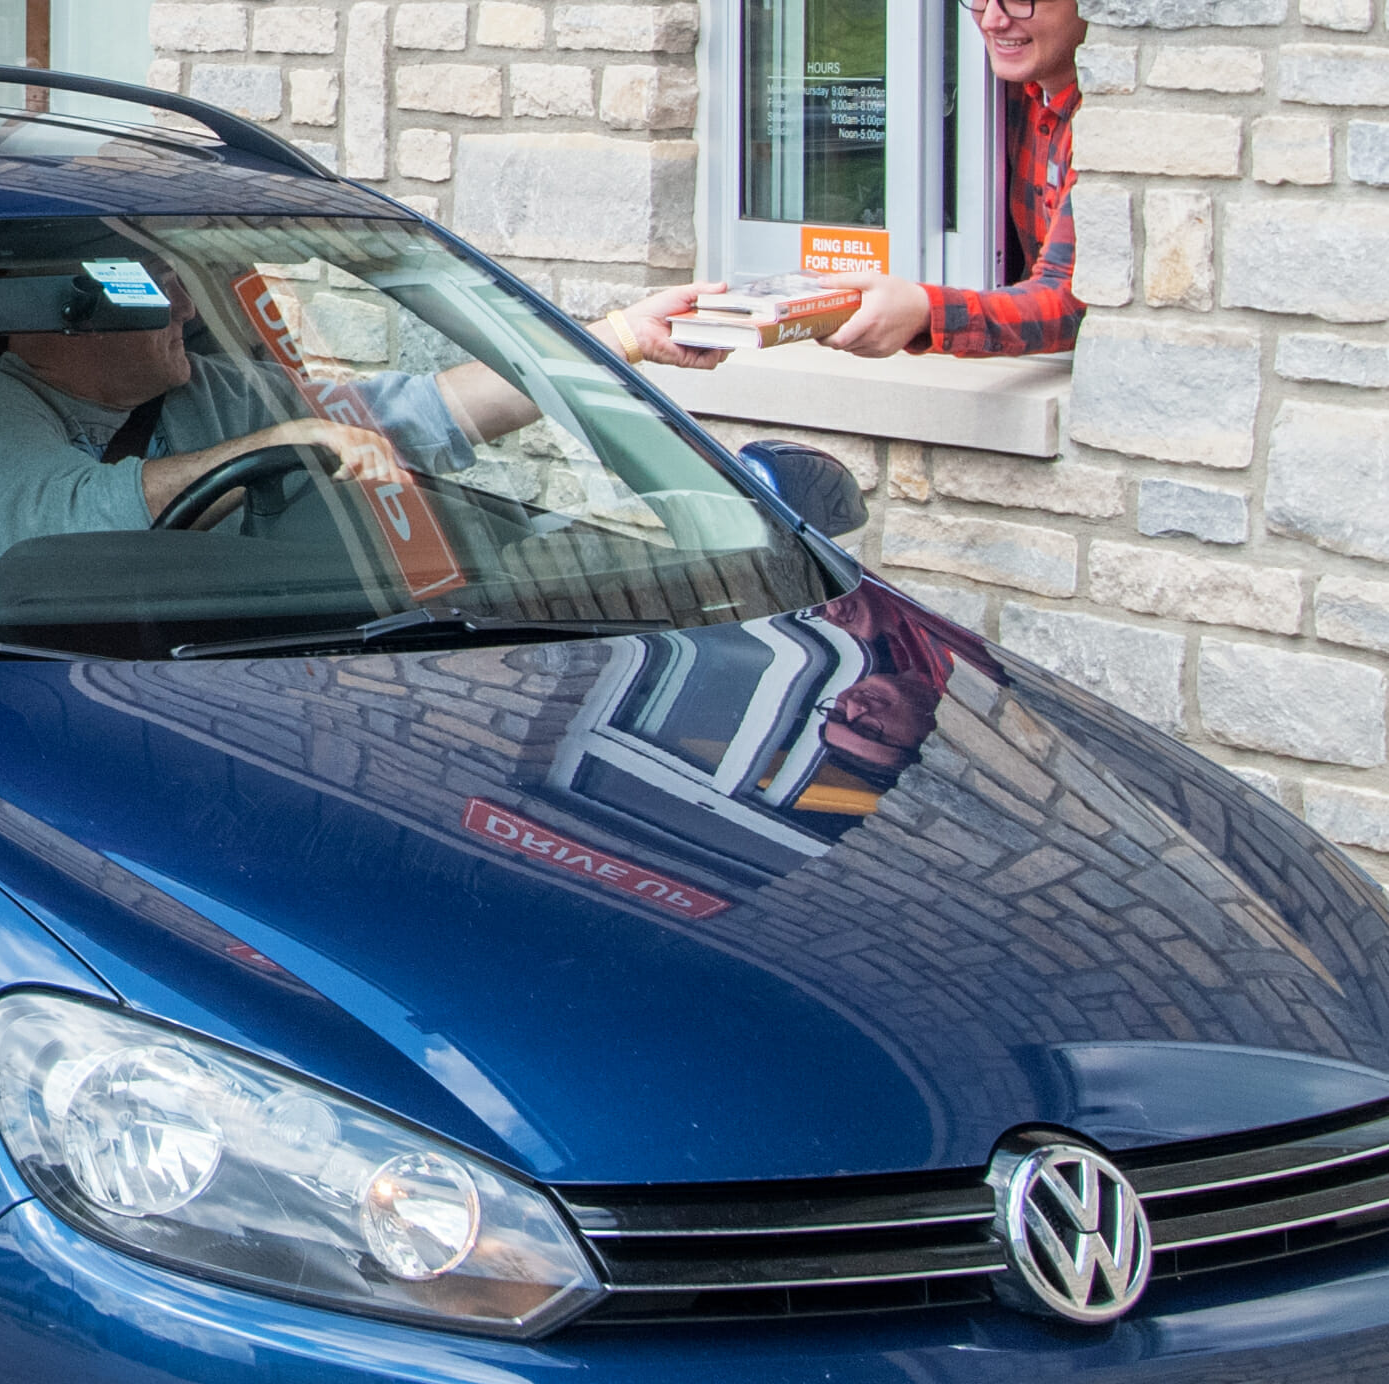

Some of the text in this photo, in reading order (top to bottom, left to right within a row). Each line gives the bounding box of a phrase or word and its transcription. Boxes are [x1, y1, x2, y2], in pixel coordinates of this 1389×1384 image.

[807, 62, 841, 74] HOURS
[812, 238, 874, 255] RING BELL
[805, 255, 882, 274] FOR SERVICE
